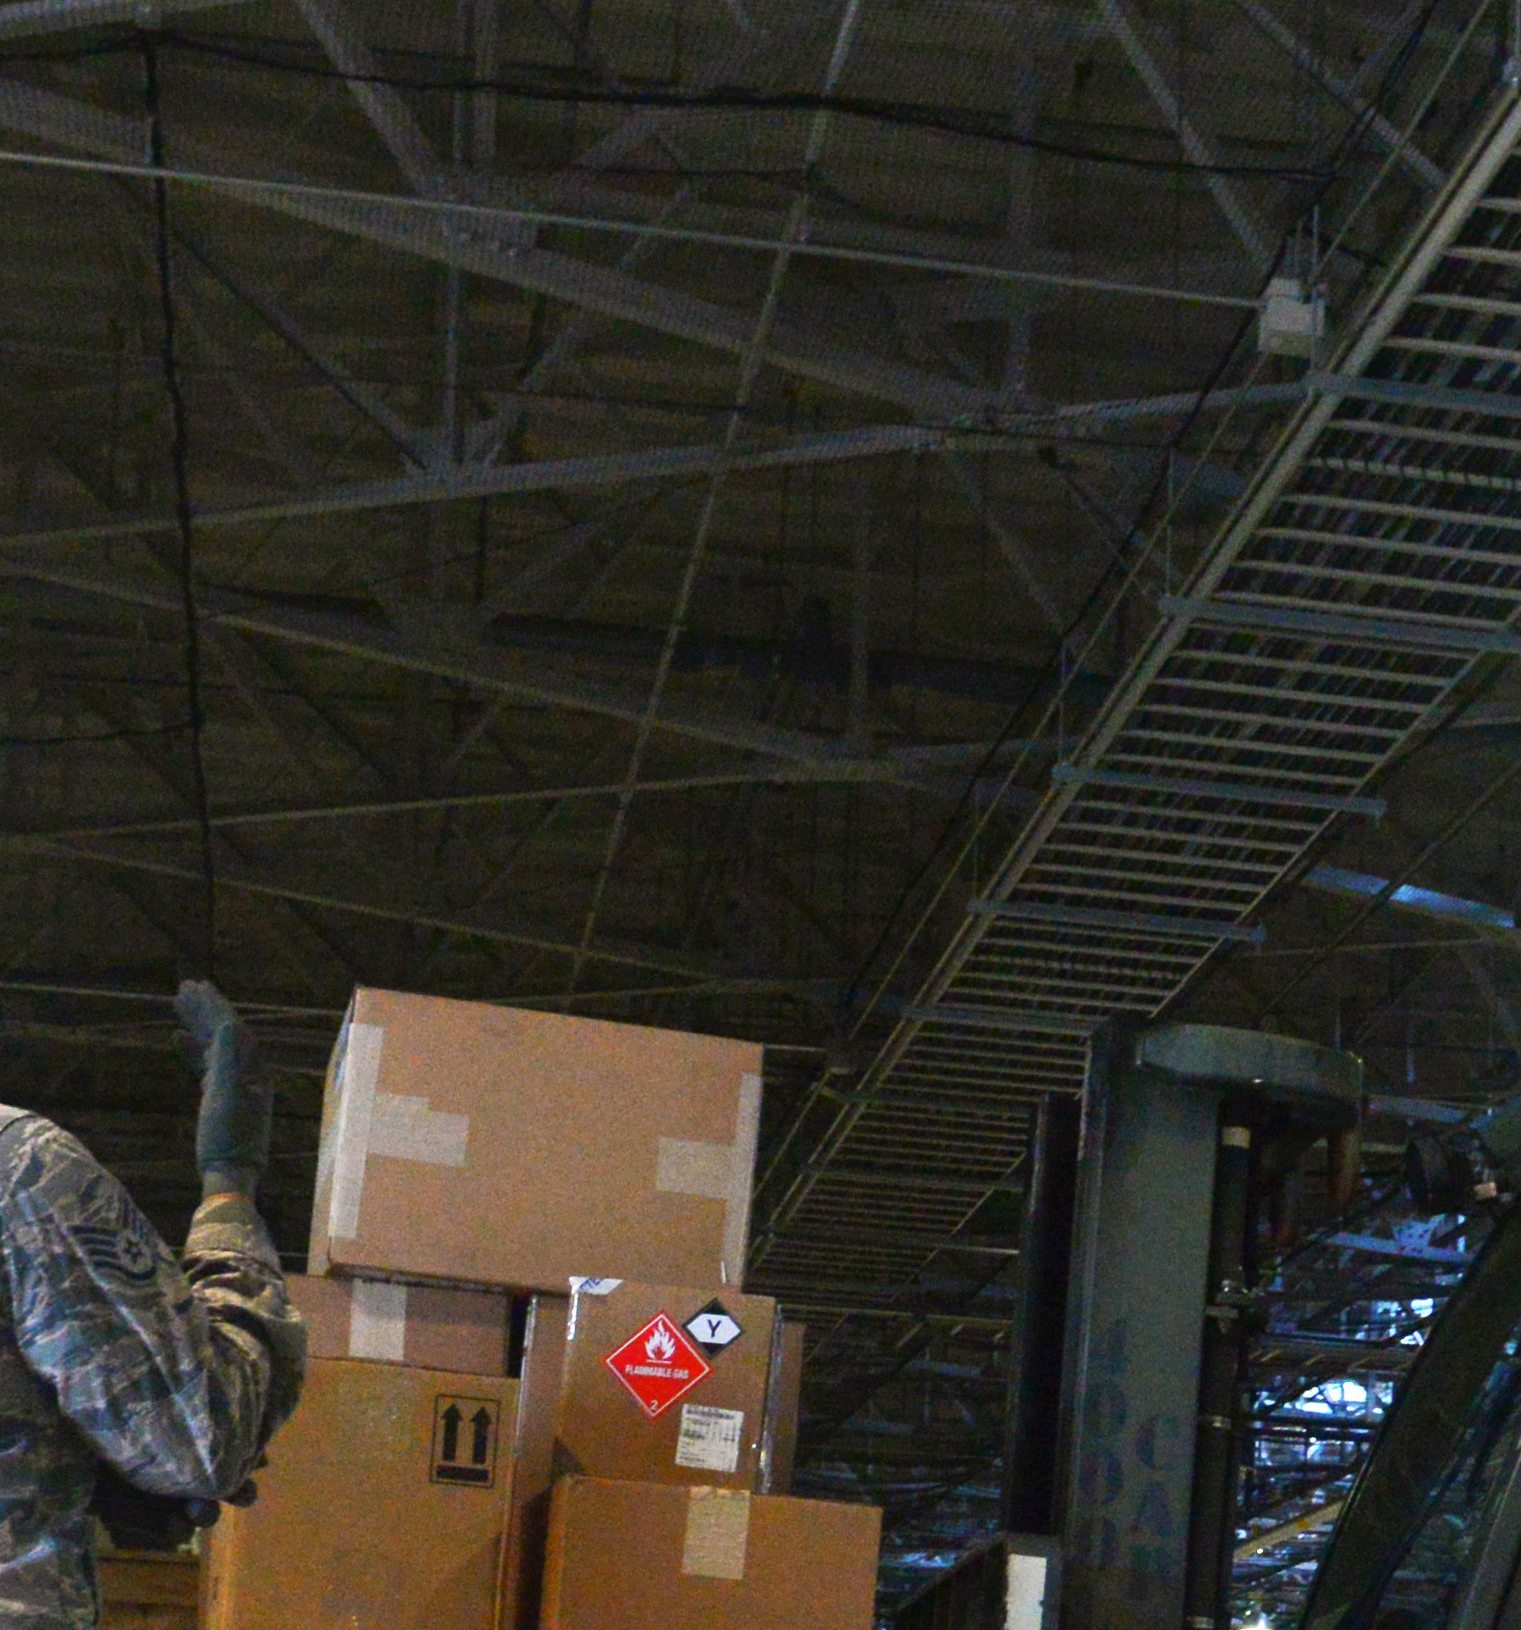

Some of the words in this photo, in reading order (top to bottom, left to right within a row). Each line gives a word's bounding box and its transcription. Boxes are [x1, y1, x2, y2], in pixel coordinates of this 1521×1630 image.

[707, 1318, 722, 1338] Y
[625, 1364, 671, 1378] FLAMMABLE
[671, 1369, 690, 1380] GAS
[649, 1399, 659, 1411] 2
